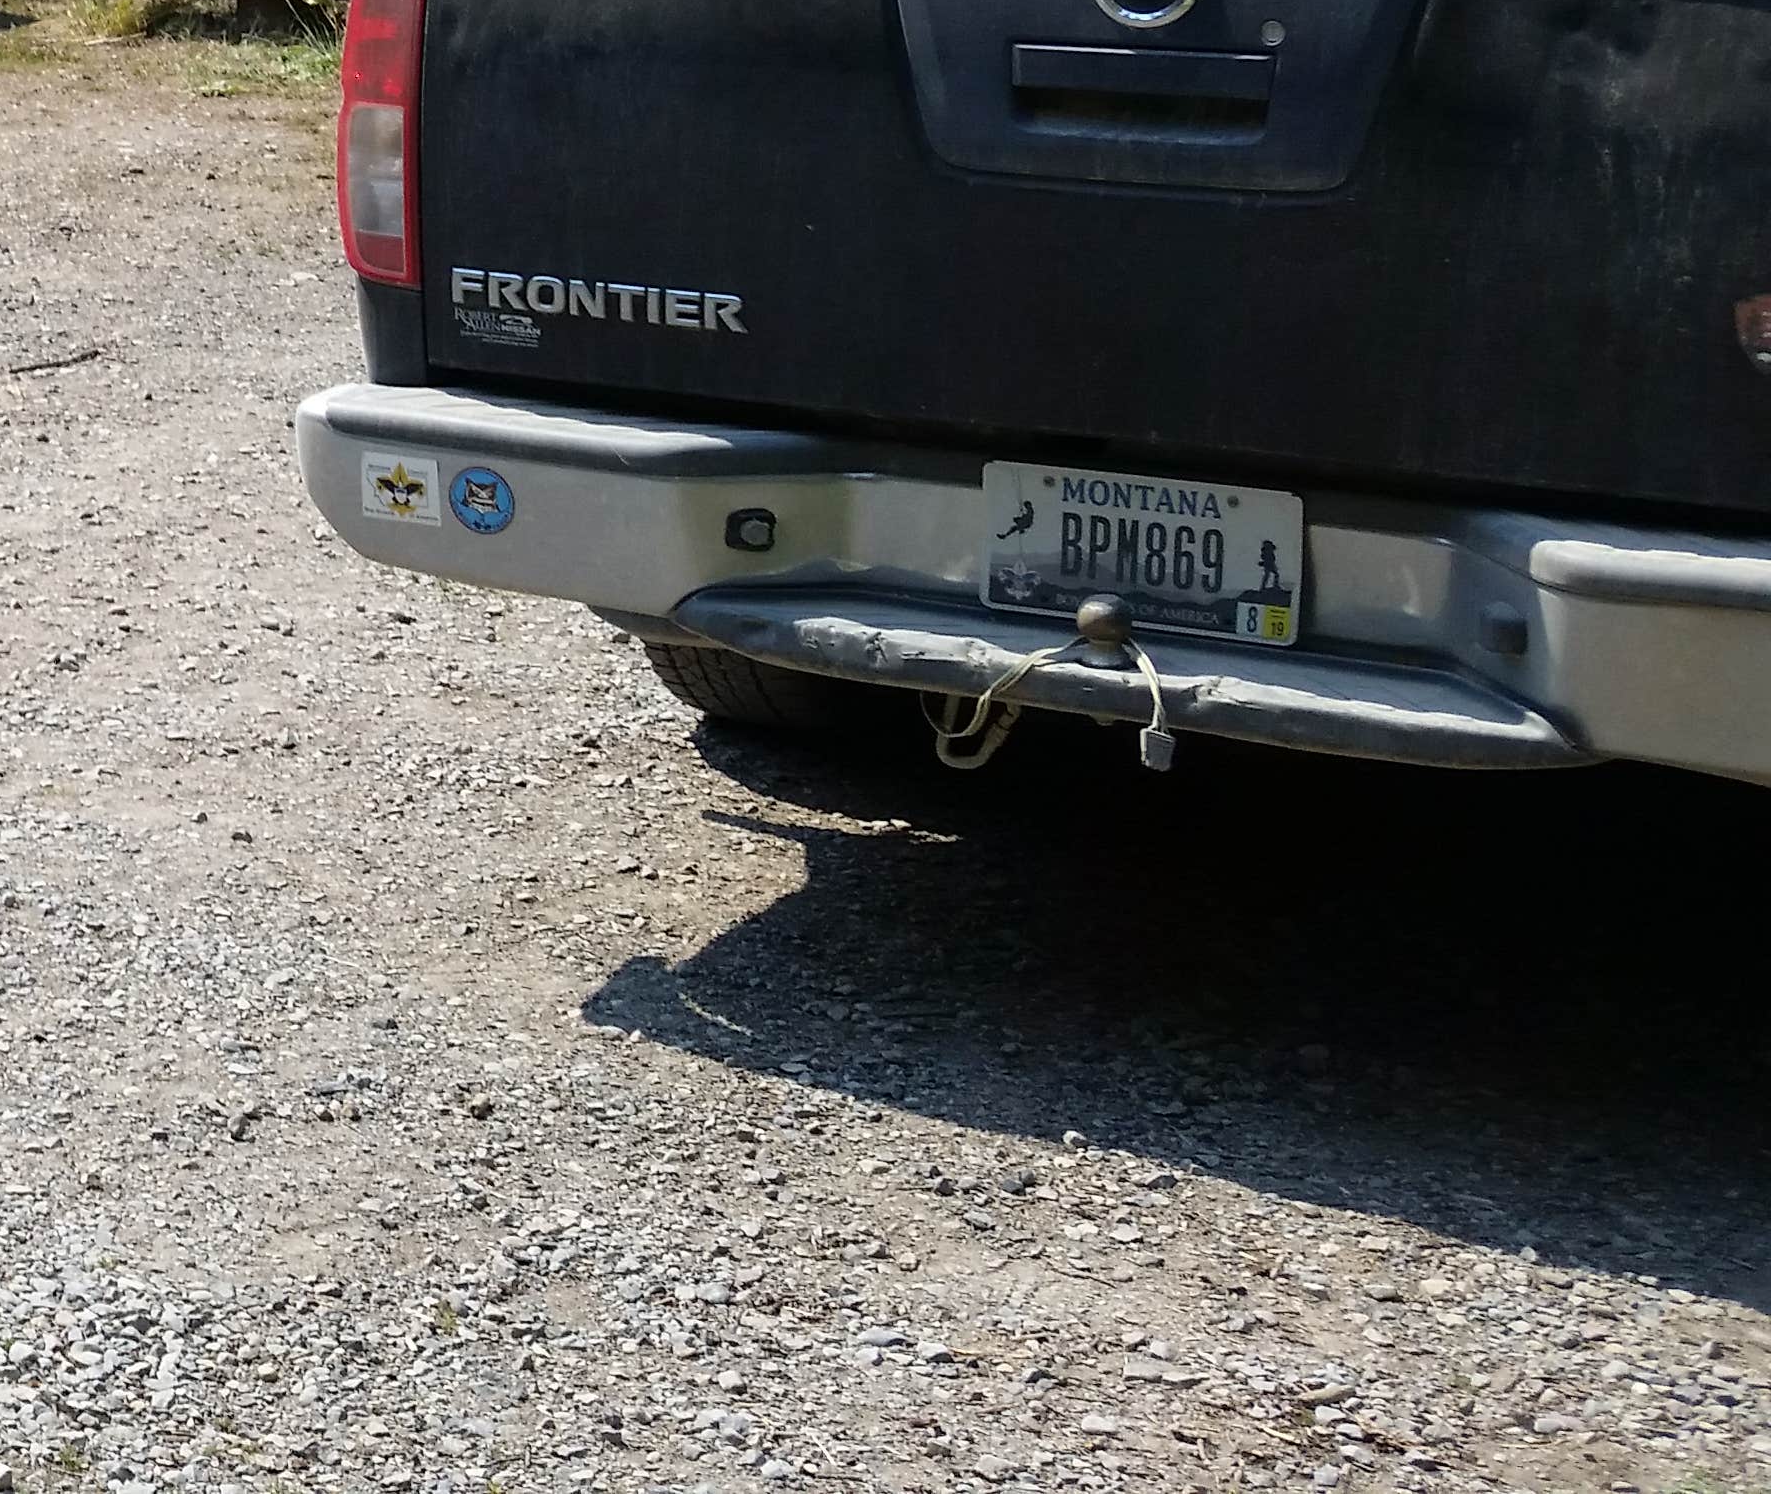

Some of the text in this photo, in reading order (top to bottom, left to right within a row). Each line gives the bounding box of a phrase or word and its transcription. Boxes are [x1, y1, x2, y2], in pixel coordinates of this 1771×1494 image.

[452, 267, 748, 334] FRONTIER
[1061, 476, 1222, 520] MONTANA
[1060, 511, 1225, 594] BPM869
[1162, 607, 1220, 626] AMERICA
[1247, 606, 1258, 633] 8
[1271, 621, 1284, 636] 19
